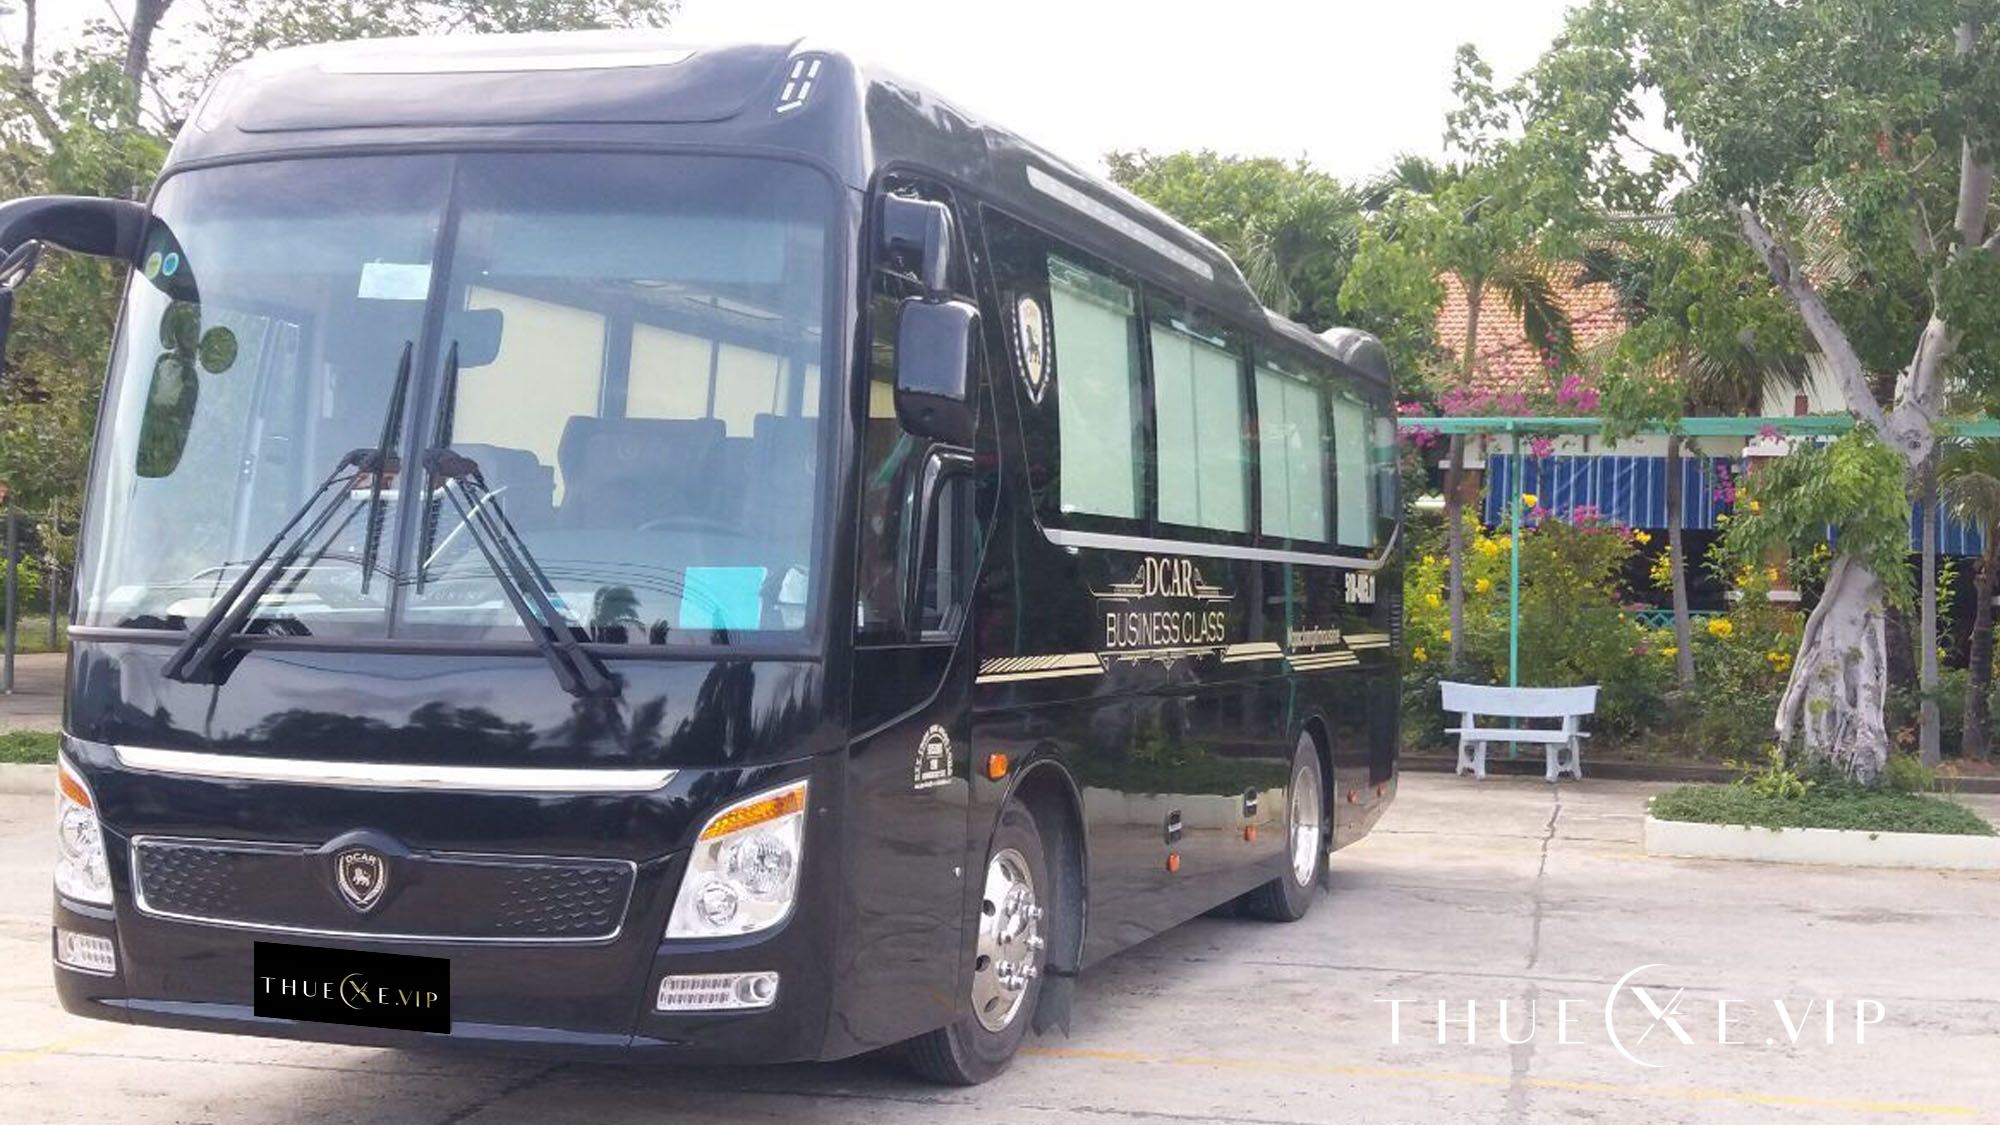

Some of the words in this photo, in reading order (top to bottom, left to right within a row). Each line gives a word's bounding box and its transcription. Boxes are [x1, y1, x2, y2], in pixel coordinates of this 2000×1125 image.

[1144, 555, 1195, 597] DCAR
[1105, 611, 1180, 648] BUSINESS
[1182, 611, 1225, 643] CLASS
